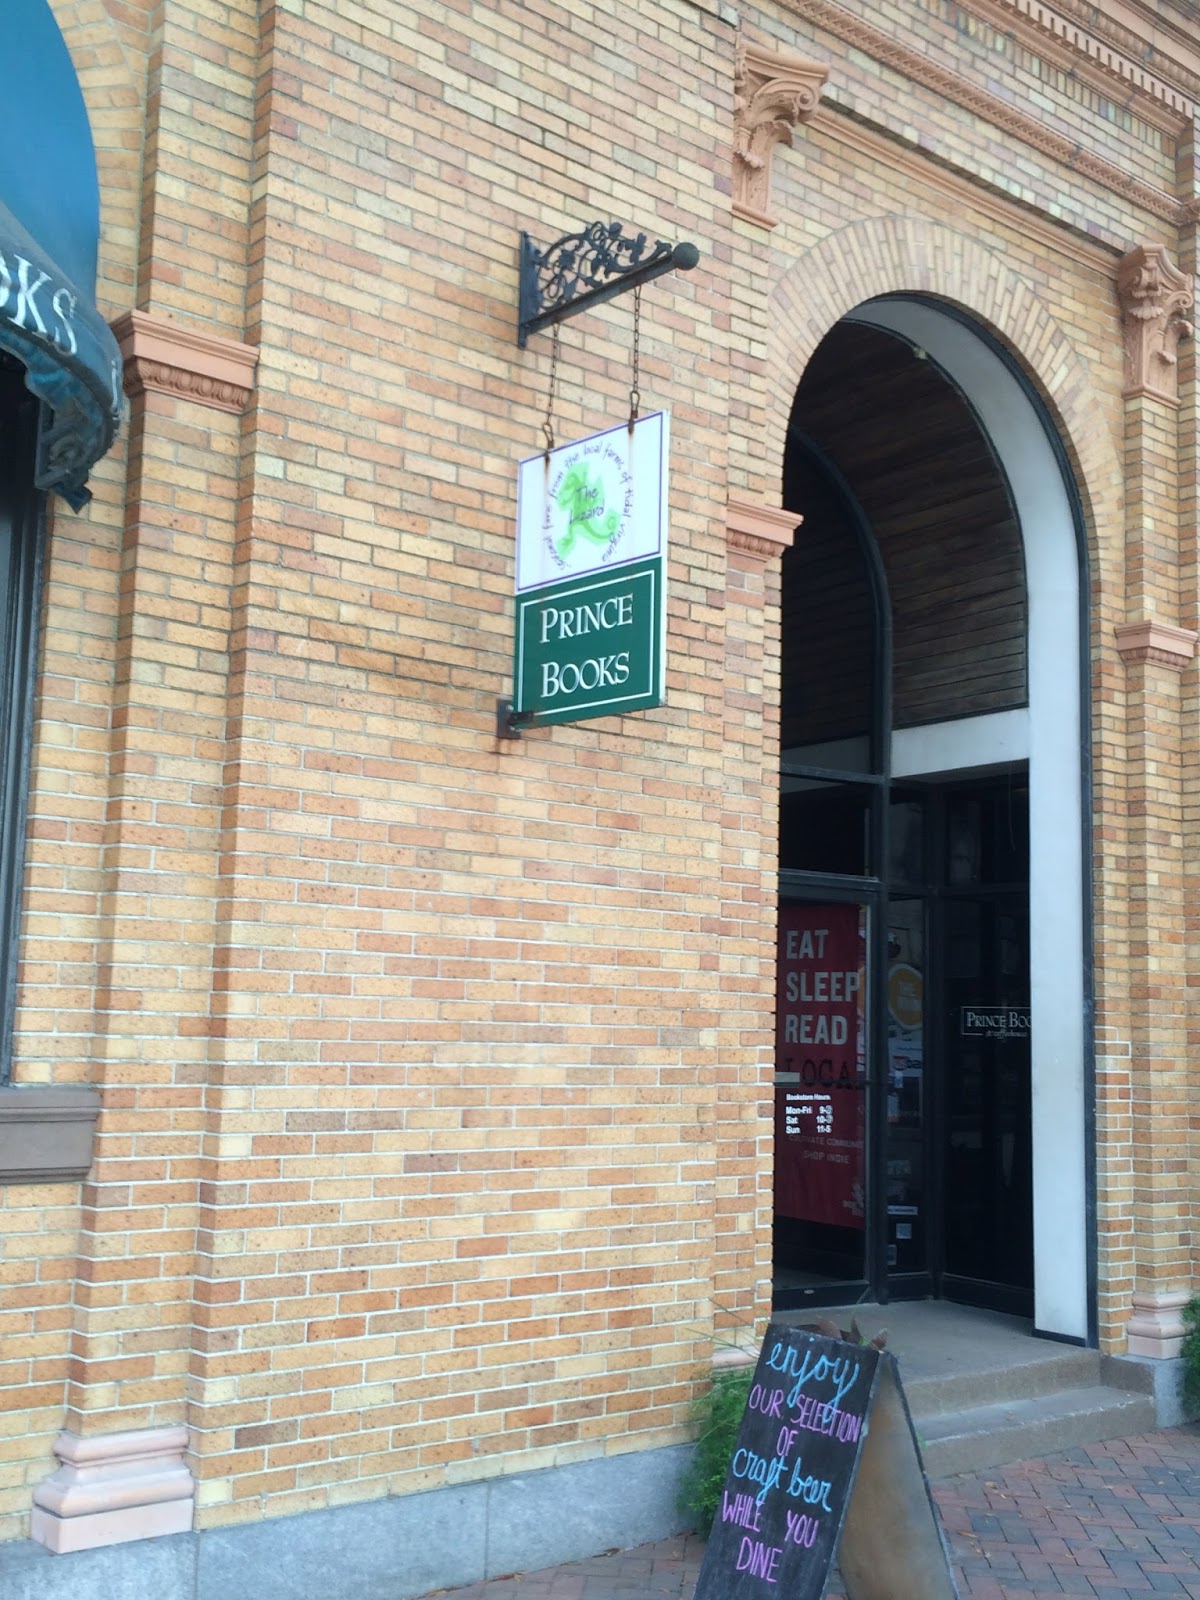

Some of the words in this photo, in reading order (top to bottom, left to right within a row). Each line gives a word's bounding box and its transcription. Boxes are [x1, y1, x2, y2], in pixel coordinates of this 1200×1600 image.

[584, 441, 603, 455] local
[620, 472, 633, 485] of
[575, 485, 600, 503] The
[570, 498, 605, 525] Lizard
[540, 593, 633, 643] PRINCE
[540, 651, 630, 698] BOOKS
[786, 929, 829, 959] EAT
[786, 971, 860, 1002] SLEEP
[784, 1014, 848, 1044] READ
[966, 1011, 1007, 1028] PRINCE
[785, 1105, 813, 1115] Mon-Fri
[785, 1115, 799, 1124] Sat
[785, 1125, 801, 1134] Sun
[803, 1150, 825, 1160] SHOP
[766, 1338, 859, 1423] enjoy
[749, 1384, 784, 1418] OUR
[790, 1393, 862, 1442] SELECTION
[777, 1426, 798, 1456] OF
[786, 1457, 831, 1511] beer
[722, 1490, 763, 1532] WHILE
[784, 1510, 818, 1548] YOU
[736, 1537, 782, 1582] DINE
